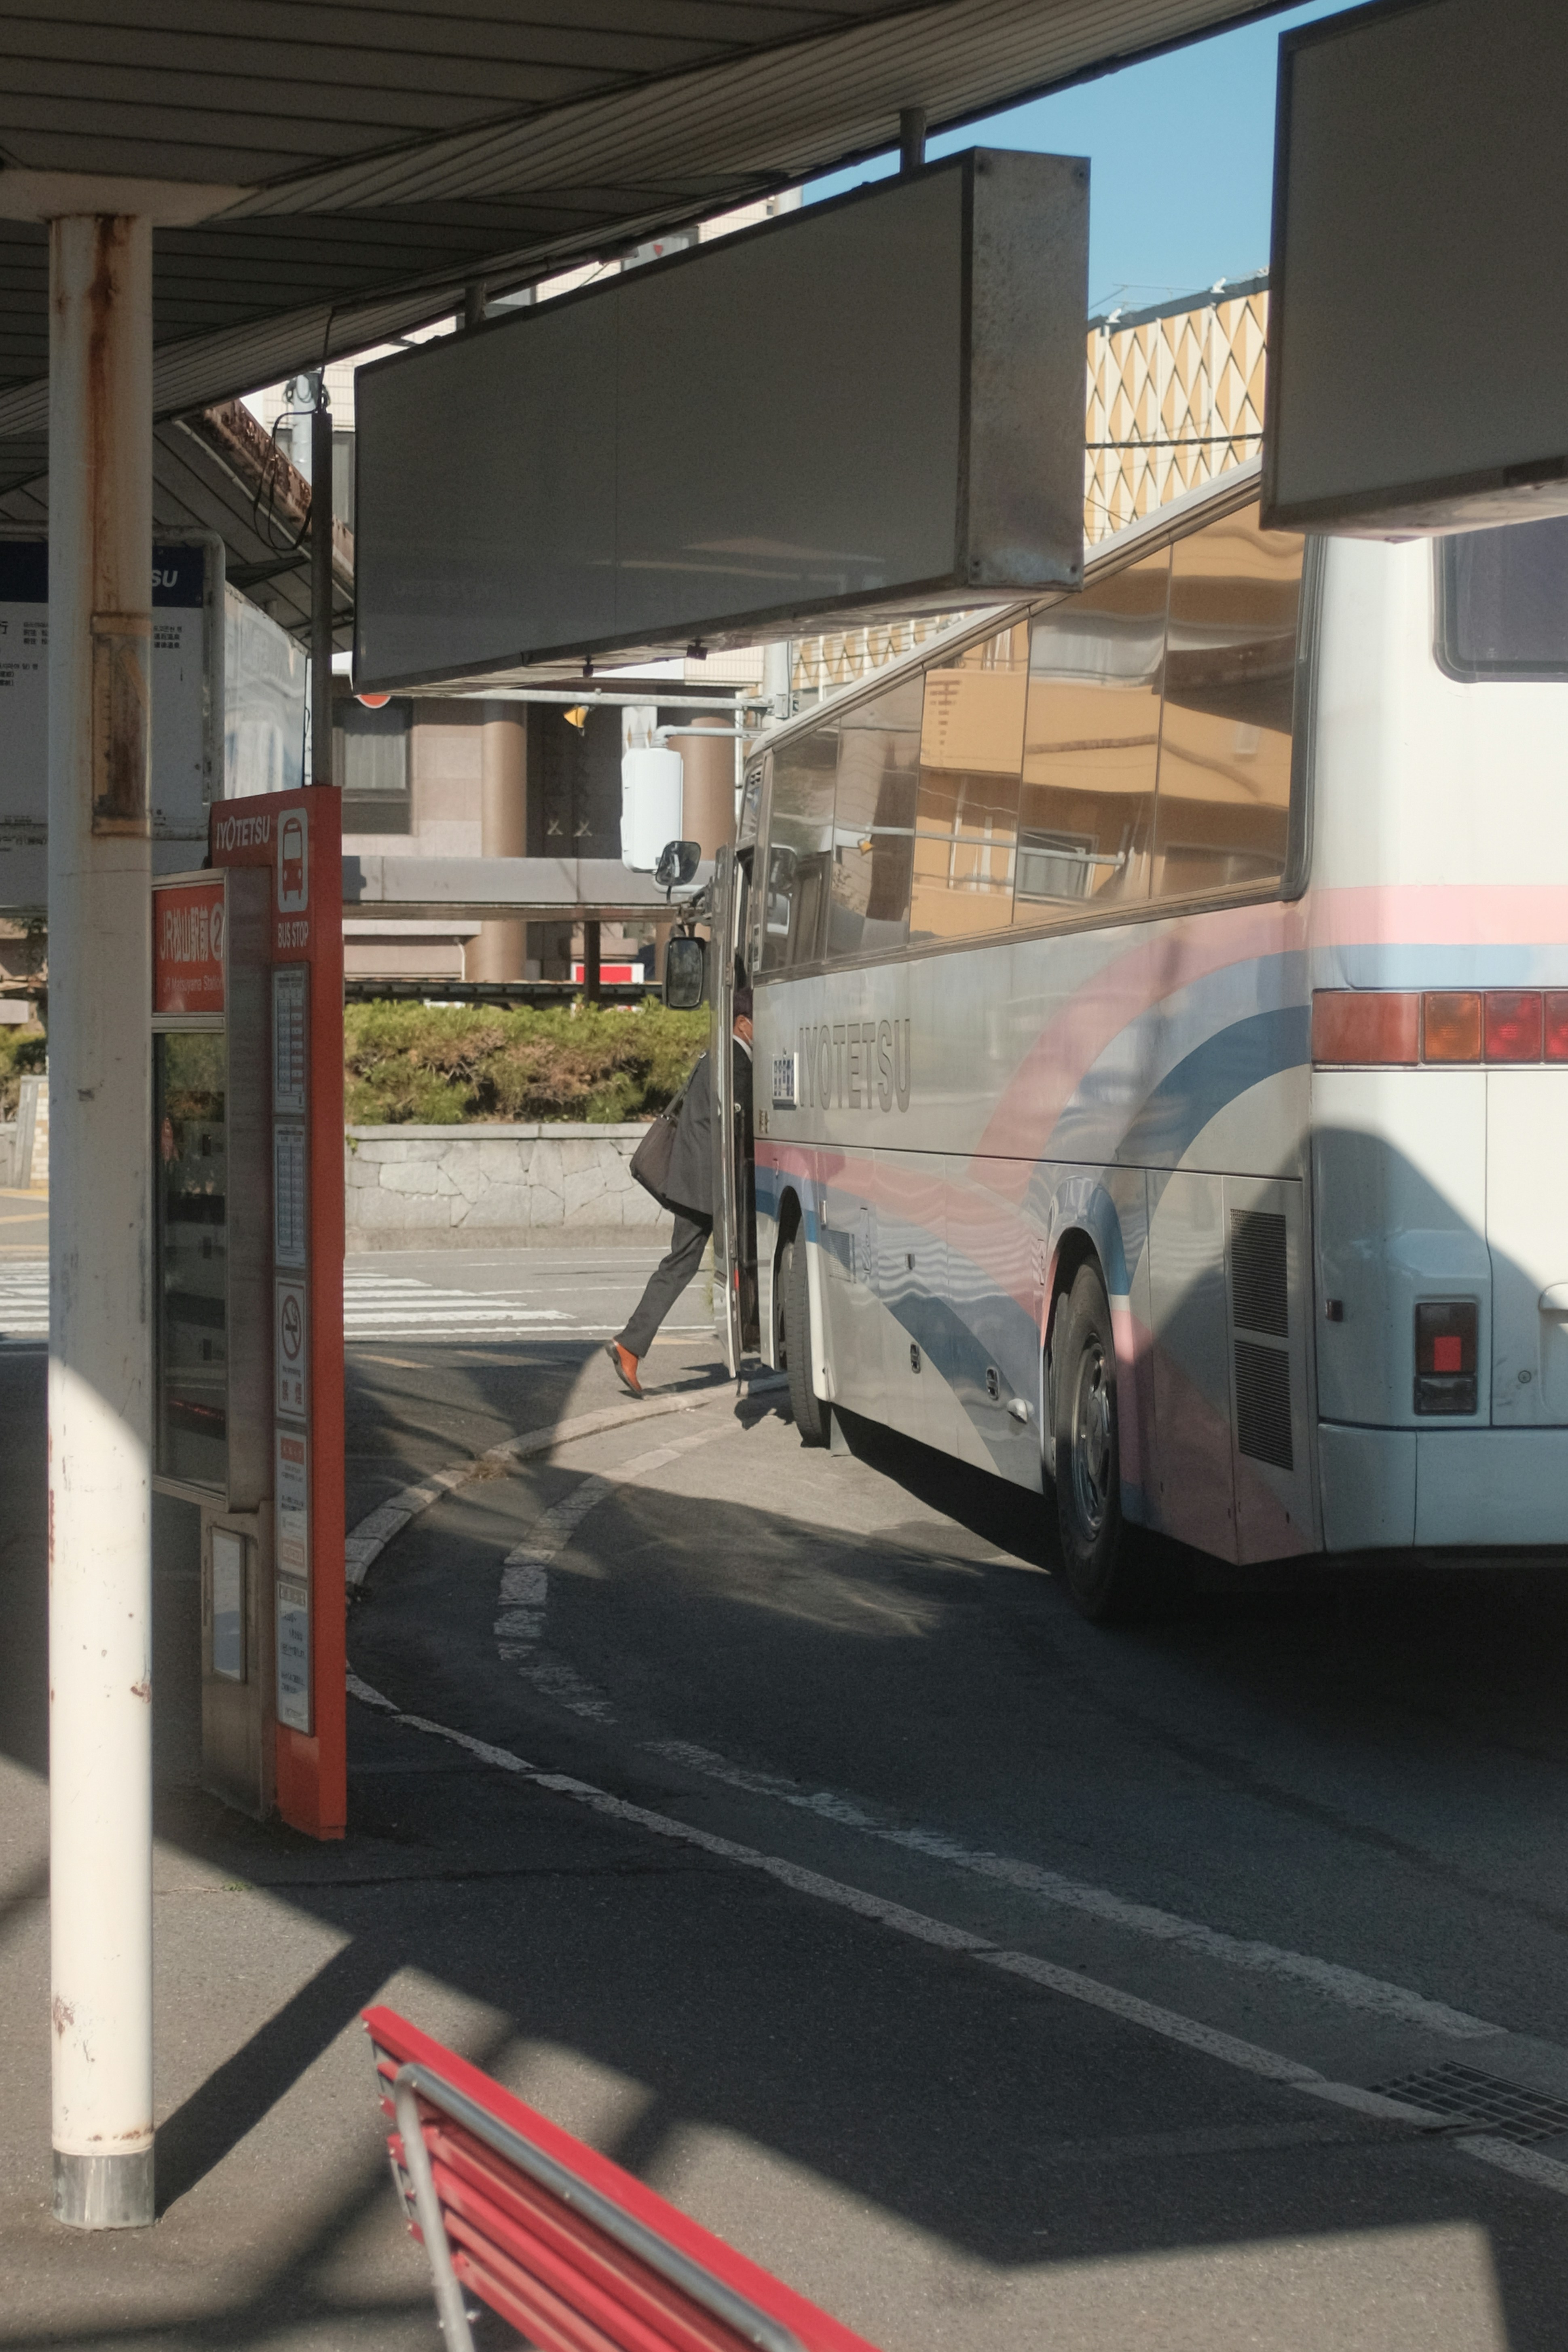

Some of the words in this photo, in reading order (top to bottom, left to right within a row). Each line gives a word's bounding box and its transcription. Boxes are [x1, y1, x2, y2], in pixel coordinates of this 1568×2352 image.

[216, 815, 271, 851] IYOTETSU
[278, 922, 290, 949] BUS
[292, 921, 308, 948] STOP
[799, 1018, 911, 1113] IYOTETSU
